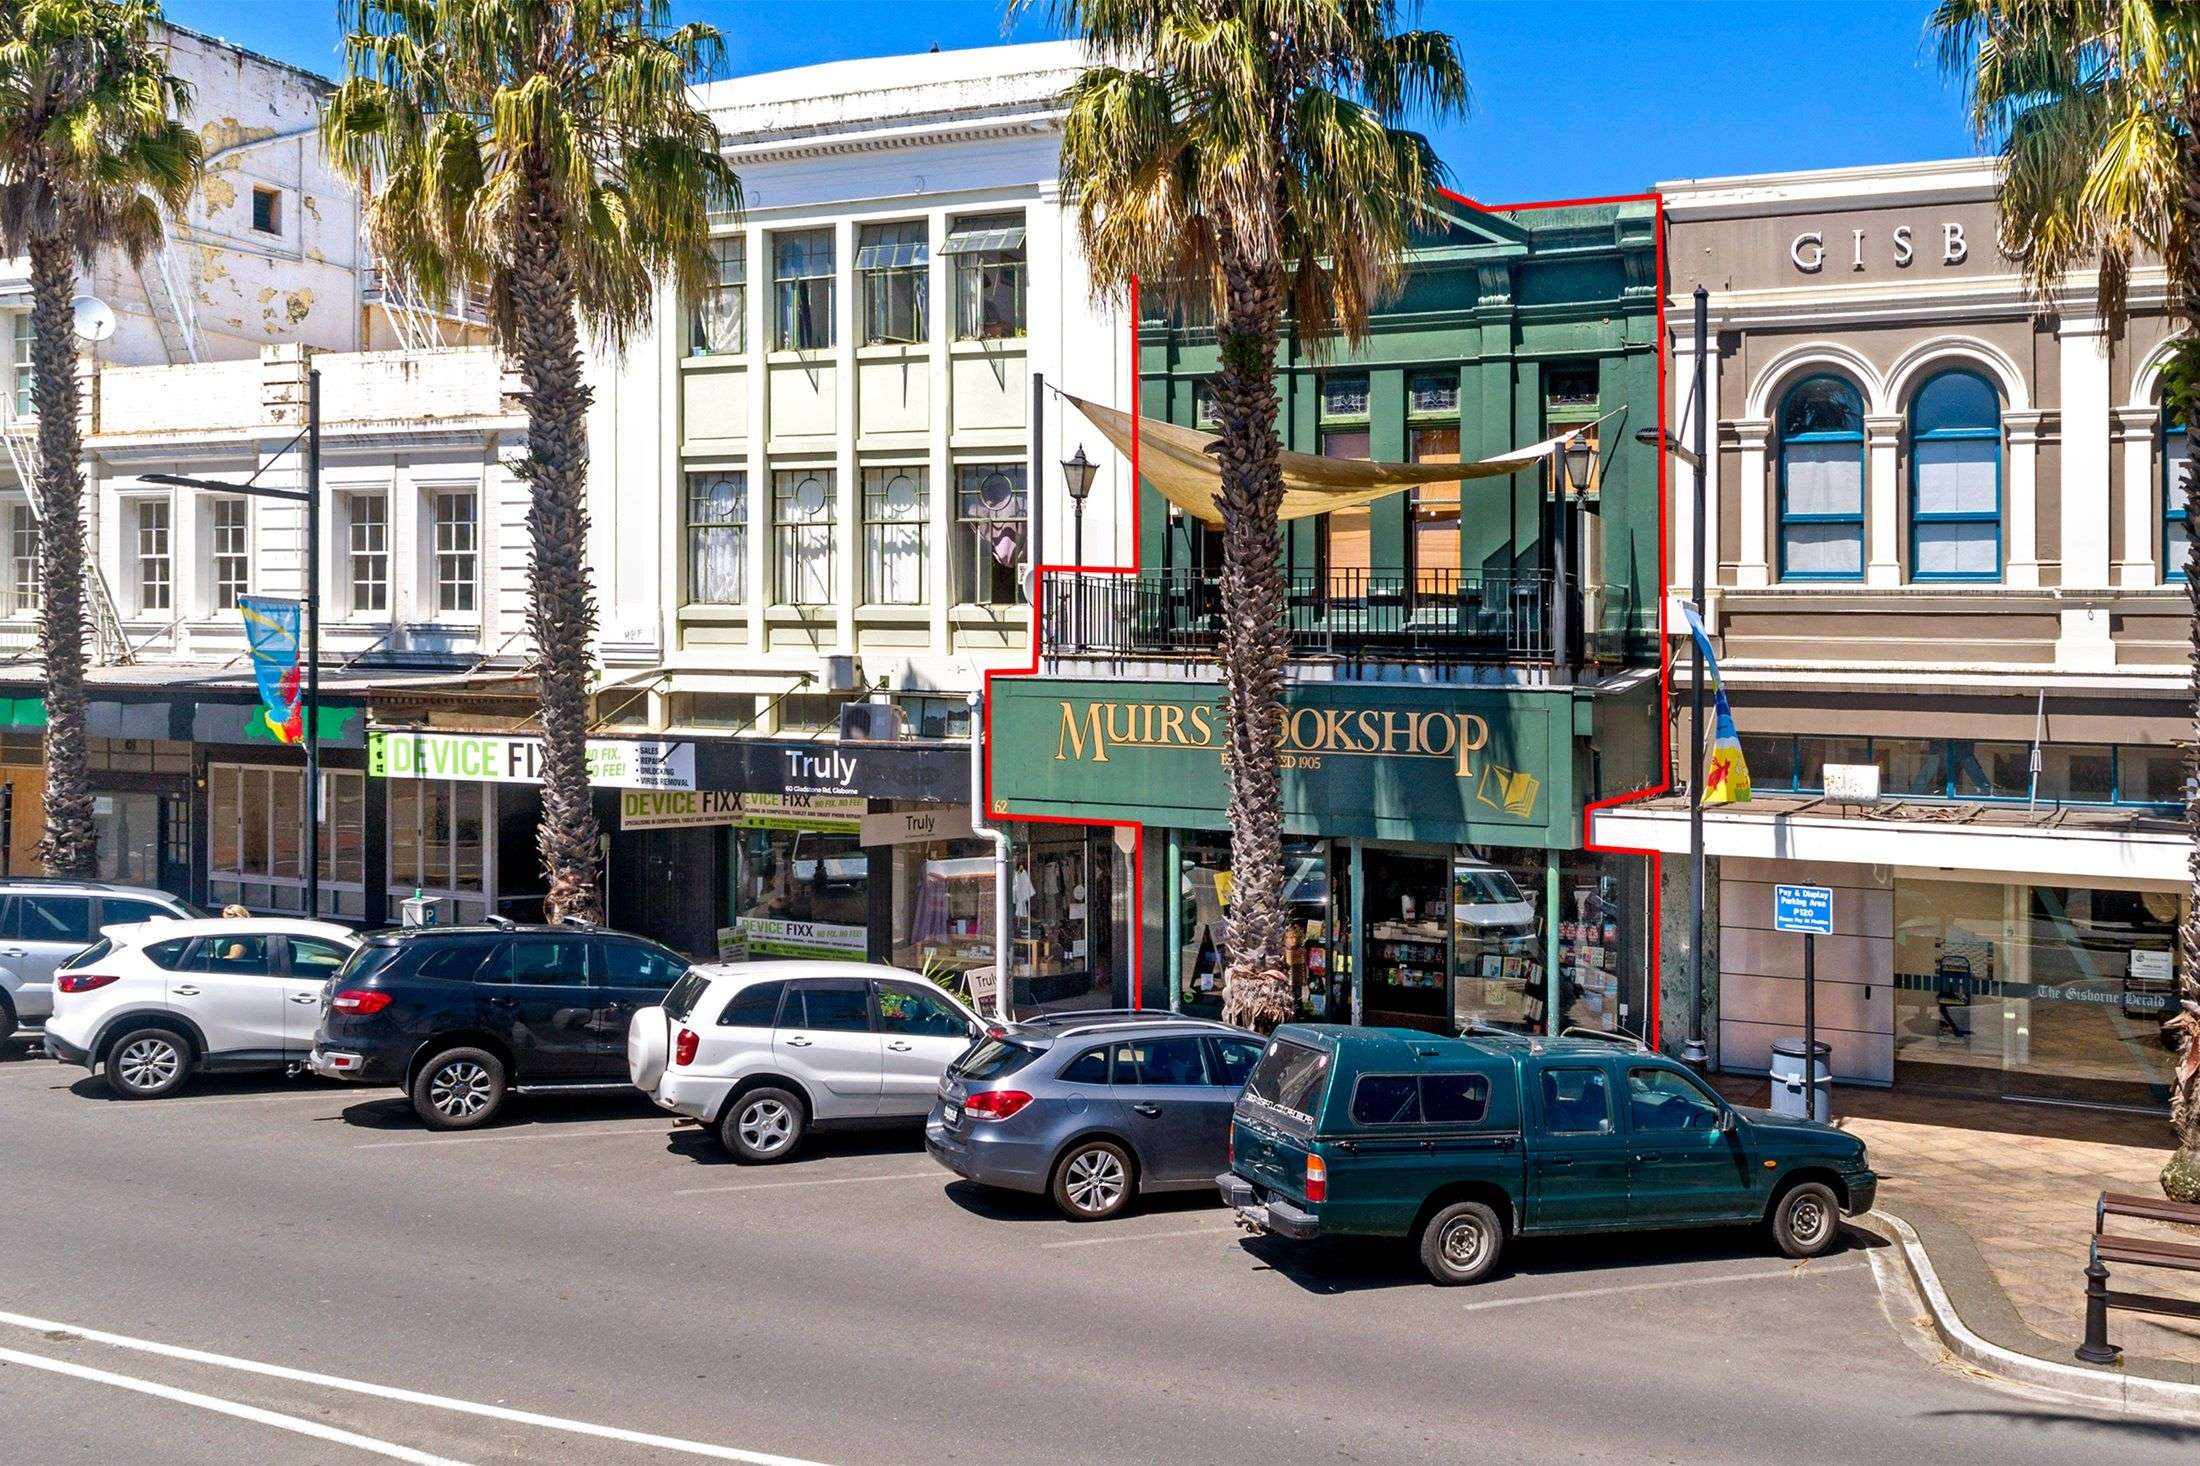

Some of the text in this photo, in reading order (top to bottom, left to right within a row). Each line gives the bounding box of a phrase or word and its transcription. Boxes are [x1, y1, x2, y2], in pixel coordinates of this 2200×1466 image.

[1055, 702, 1489, 777] MUIRS OKSHOP
[640, 746, 658, 755] SALES
[393, 738, 499, 777] DEVICE
[640, 757, 667, 765] REPAIS
[1298, 756, 1321, 769] 1905
[603, 764, 626, 777] FEE!
[785, 750, 857, 786] Truly
[641, 777, 658, 785] VIRUS
[832, 787, 858, 795] Gisborne
[625, 791, 743, 816] DEVICE FIXX
[745, 793, 779, 806] EVICE
[782, 795, 812, 808] FIXX
[995, 799, 1008, 814] 62
[905, 814, 935, 832] Truly
[1779, 888, 1829, 900] Pay & Display
[1781, 896, 1827, 908] Parking Area
[426, 909, 434, 921] P
[1793, 907, 1814, 917] P120
[743, 919, 784, 935] DEVICE
[786, 923, 814, 938] FIXX
[2037, 984, 2166, 1008] The Gisborne Herald
